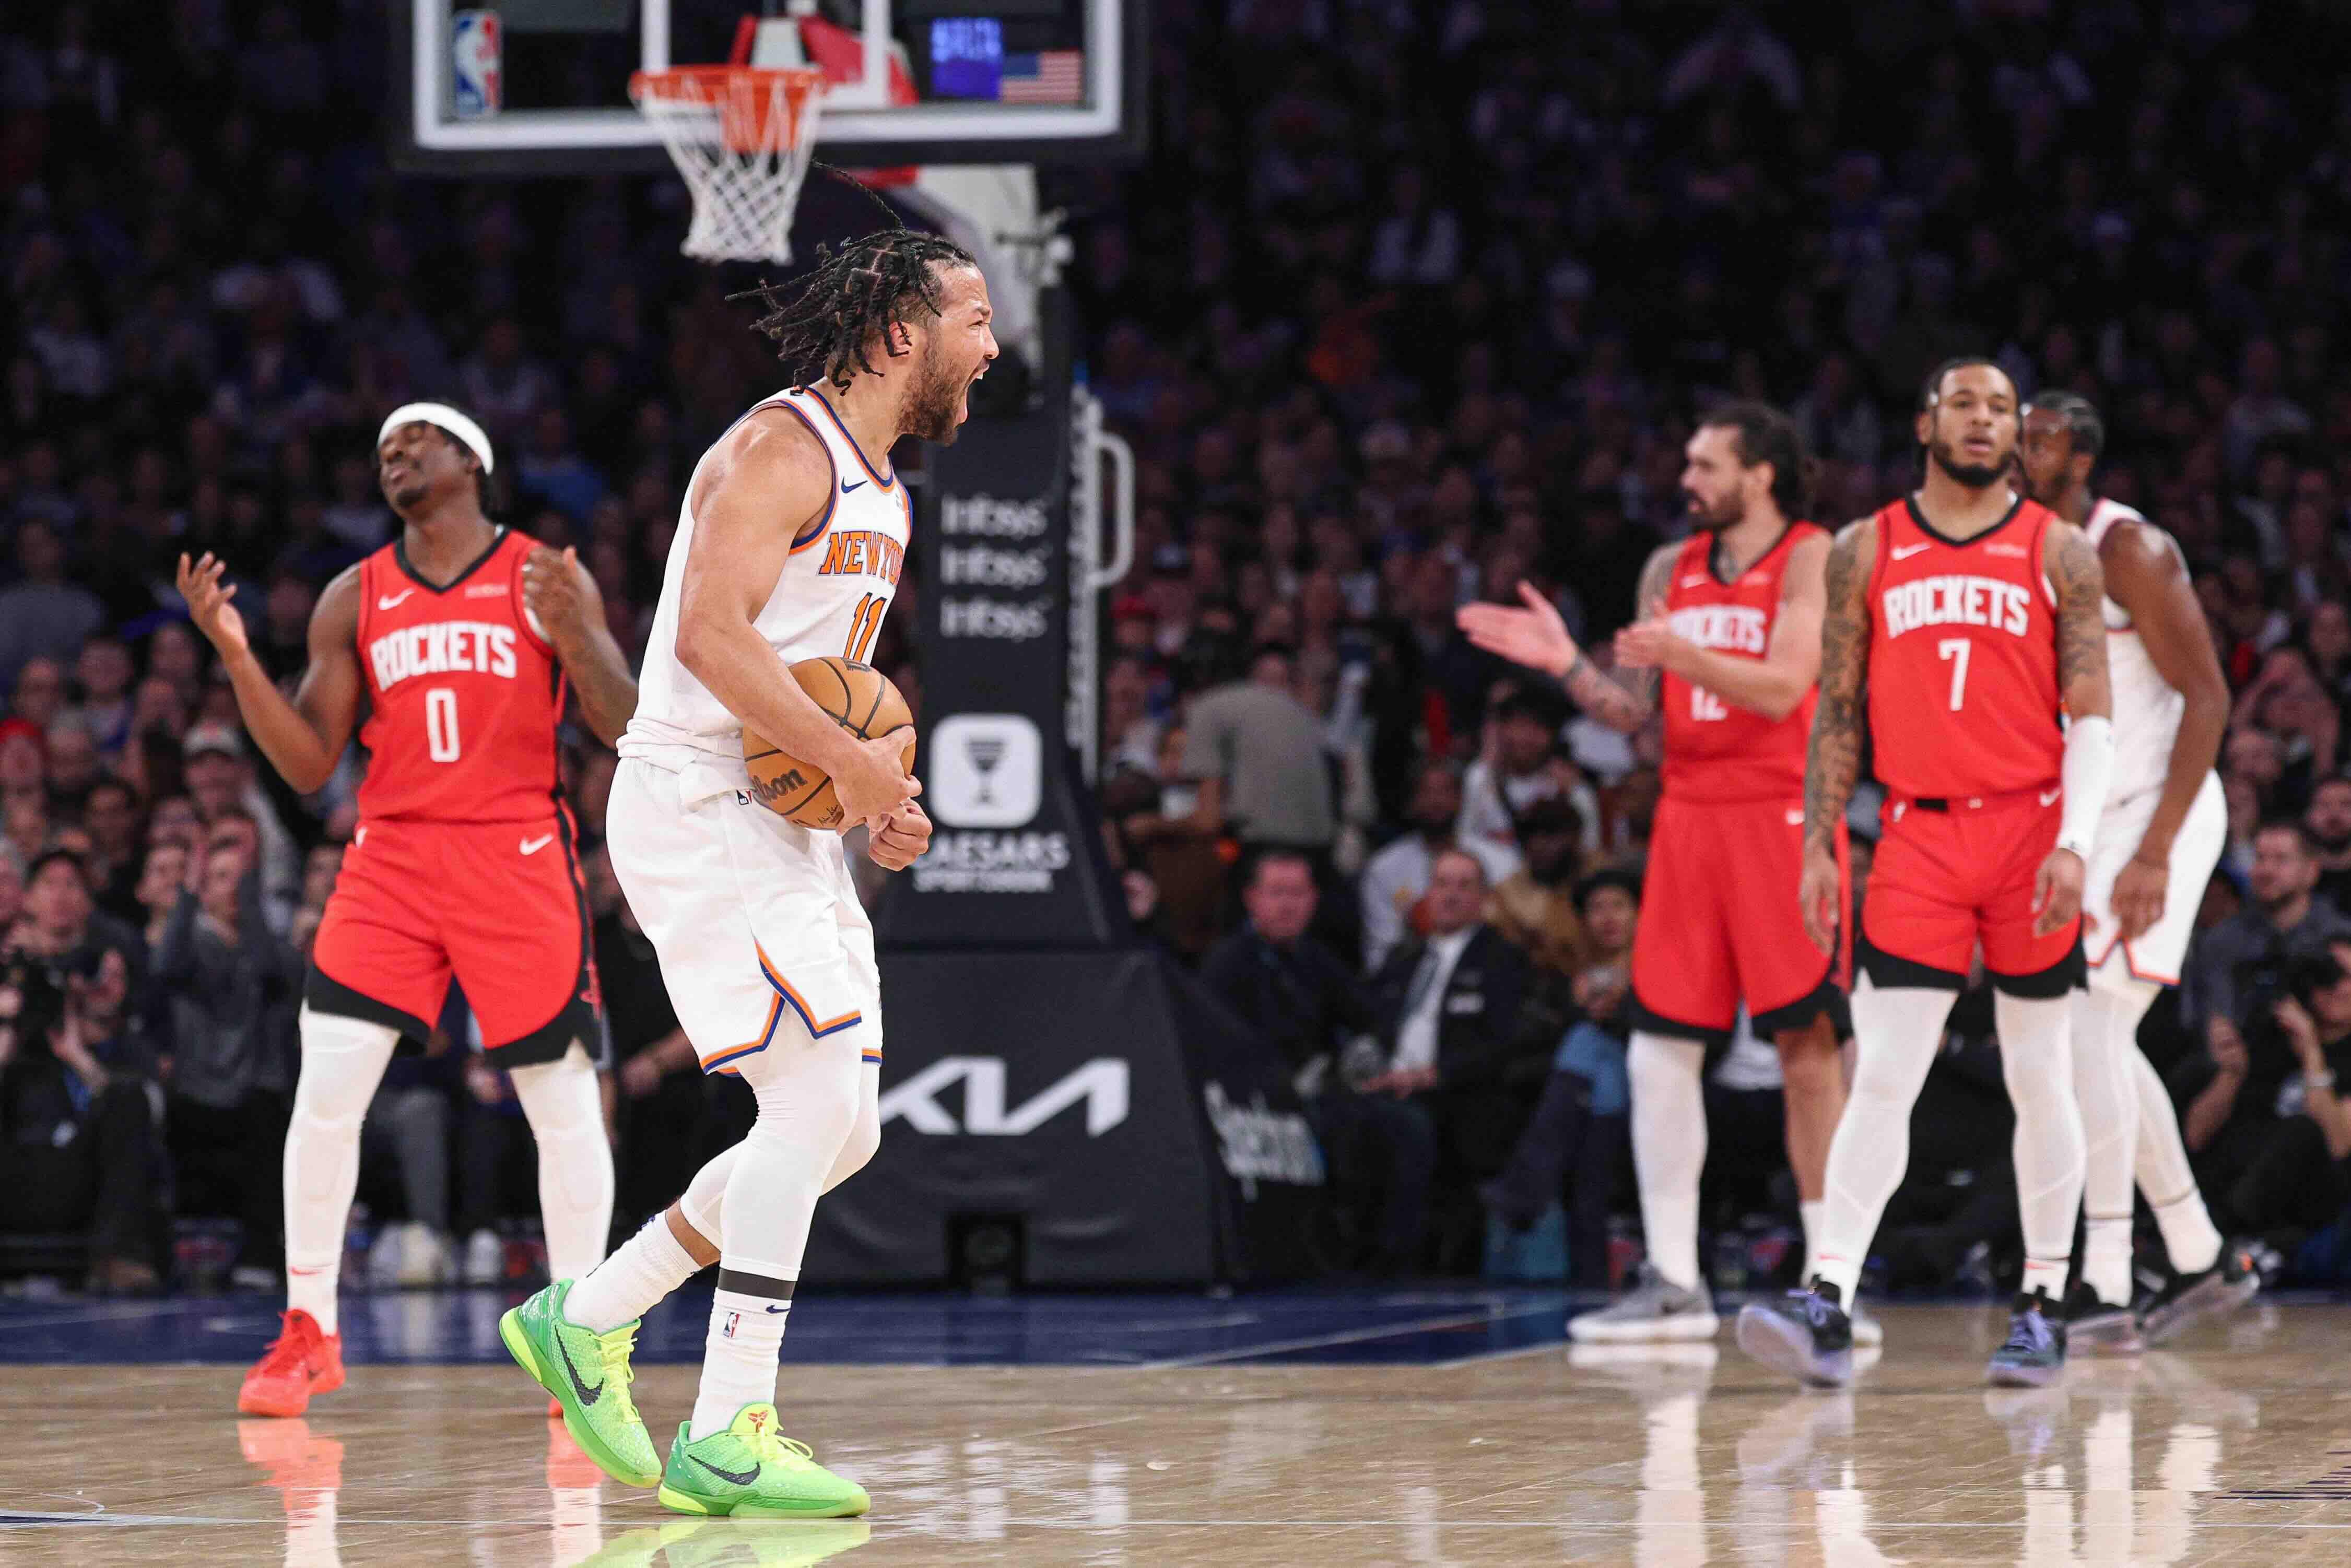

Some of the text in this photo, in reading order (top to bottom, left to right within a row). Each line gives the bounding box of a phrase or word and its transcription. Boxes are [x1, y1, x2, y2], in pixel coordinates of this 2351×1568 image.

[817, 530, 904, 585] NEW YO
[843, 592, 887, 662] 11
[1883, 574, 2030, 638] ROCKETS
[370, 621, 516, 691] ROCKETS
[1938, 638, 1971, 711] 7
[426, 688, 460, 763] 0
[916, 832, 1071, 869] AESARS
